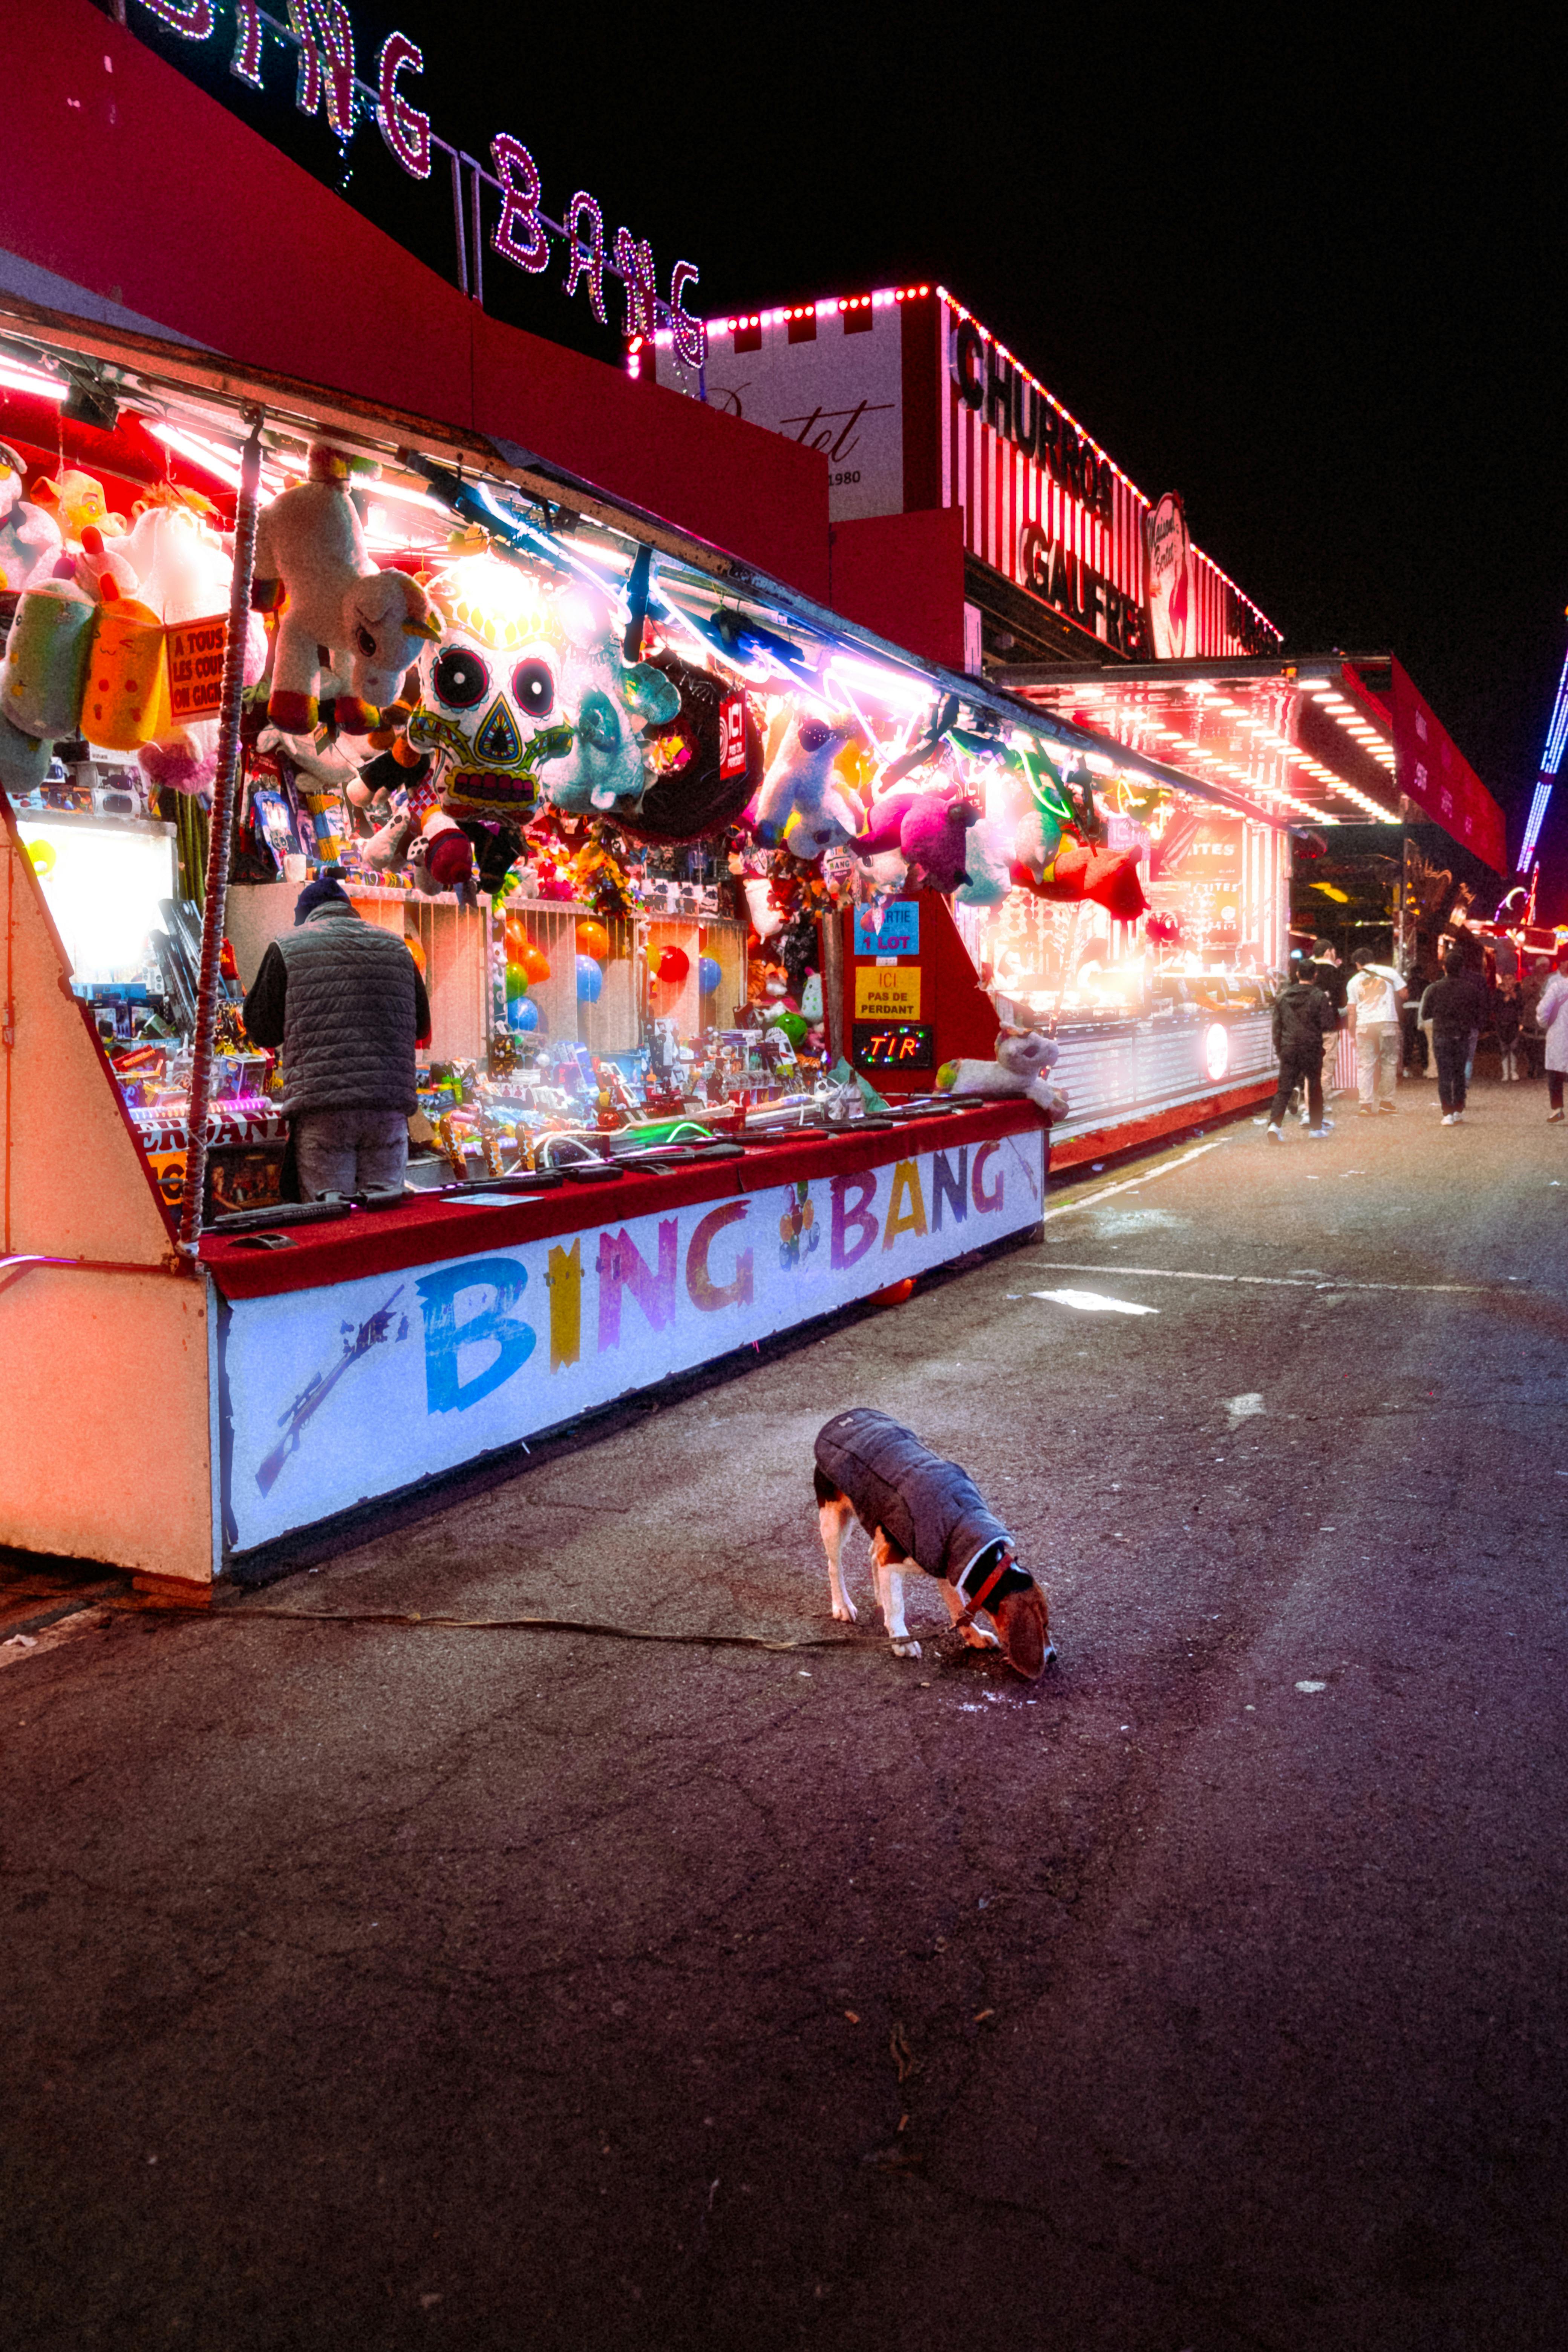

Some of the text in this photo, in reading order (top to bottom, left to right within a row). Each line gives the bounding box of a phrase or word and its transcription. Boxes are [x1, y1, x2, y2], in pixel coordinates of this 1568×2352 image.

[138, 0, 704, 369] ING BANG
[829, 470, 861, 485] 1980
[175, 627, 224, 657] A TOUS
[173, 654, 224, 682] LES COUP
[174, 681, 222, 709] ON GAGN
[728, 703, 742, 740] ICI
[1188, 843, 1235, 856] ITES
[864, 936, 910, 949] 1 LOT
[879, 972, 896, 988] ICI
[868, 992, 907, 1001] PAS DE
[861, 1004, 914, 1014] PERDANT
[870, 1037, 917, 1059] TIR
[414, 1139, 1005, 1415] BING BANG
